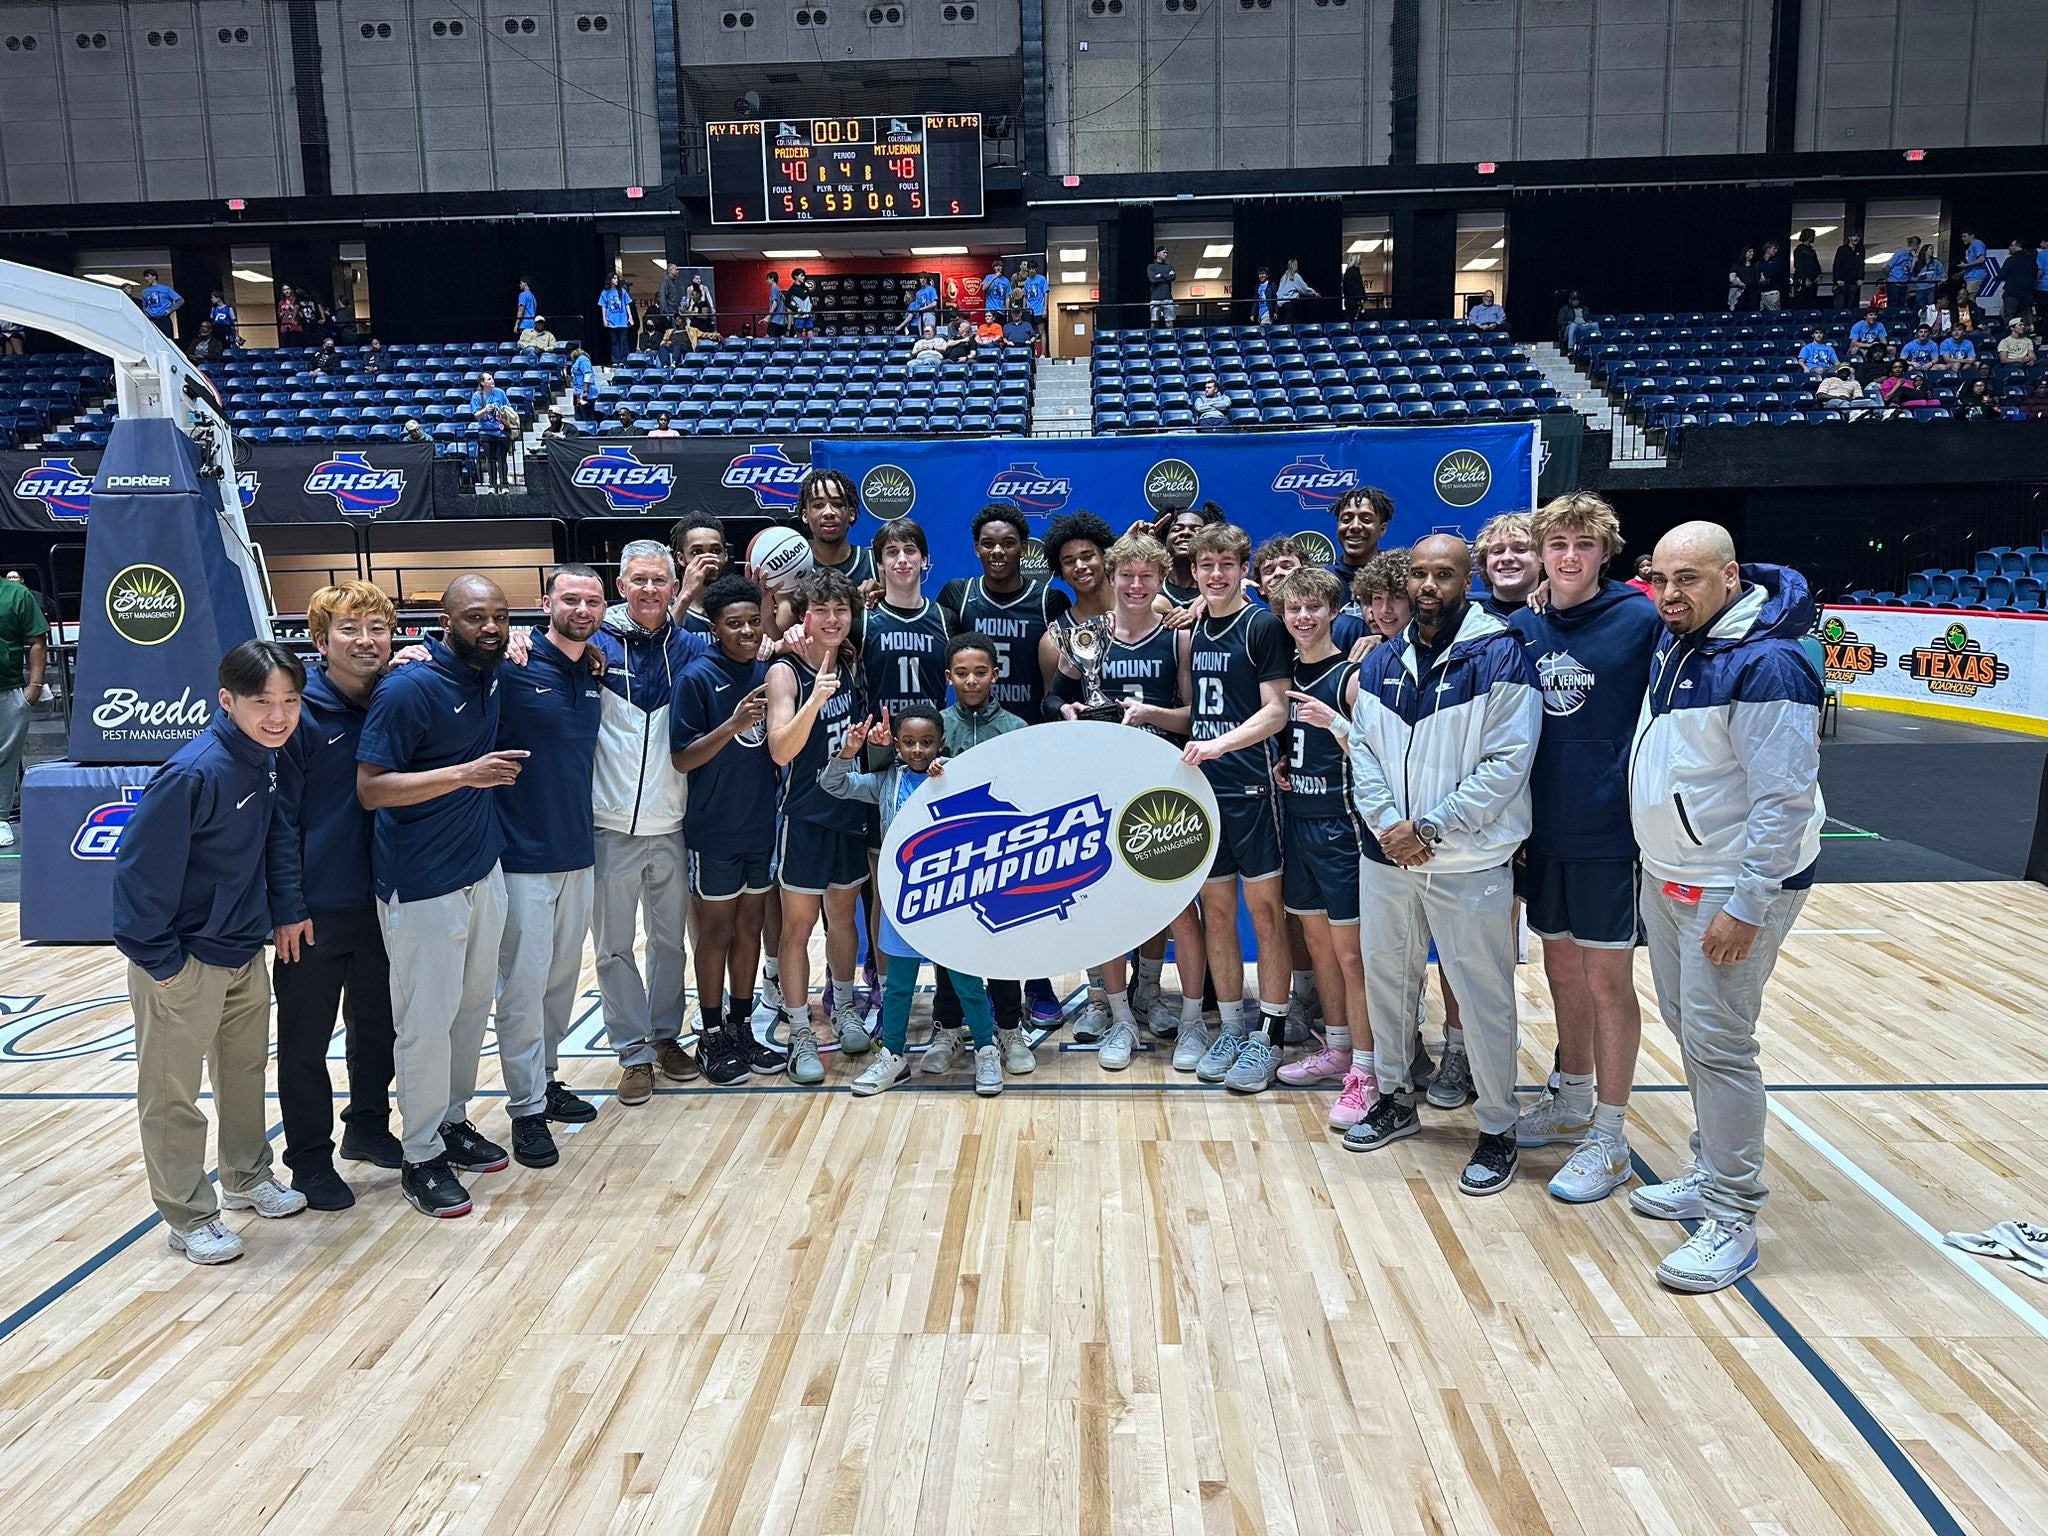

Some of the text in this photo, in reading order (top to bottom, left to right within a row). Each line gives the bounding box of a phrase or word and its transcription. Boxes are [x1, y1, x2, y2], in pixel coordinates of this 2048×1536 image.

[709, 123, 760, 136] PLY FL PTS
[815, 121, 859, 142] 00.0
[927, 116, 978, 128] PLY FL PTS
[775, 147, 809, 159] PAIDEIA
[874, 144, 920, 155] MT.VERNON
[781, 160, 807, 181] 40
[840, 162, 850, 177] 4
[889, 158, 915, 179] 48
[772, 186, 793, 194] FOULS
[838, 184, 854, 192] FOUL
[862, 183, 874, 191] PTS
[899, 182, 919, 190] FOULS
[107, 475, 170, 488] porter
[307, 472, 403, 492] GHSA
[574, 466, 673, 485] GHSA
[1273, 472, 1357, 490] GHSA
[1439, 464, 1488, 483] Breda
[16, 479, 94, 496] GHS
[865, 481, 911, 497] Breda
[989, 478, 1070, 496] GHSA
[1149, 476, 1194, 492] Breda
[766, 540, 806, 571] Wilson
[1020, 554, 1049, 568] reda
[1309, 548, 1331, 562] eda
[113, 588, 178, 612] Breda
[134, 611, 176, 619] MANAGEMENT
[974, 617, 1029, 638] MOUNT
[880, 632, 934, 652] MOUNT
[993, 642, 1010, 678] 5
[1192, 652, 1231, 672] MOUNT
[1825, 645, 1872, 671] XAS
[1916, 651, 1994, 684] TEXAS
[898, 656, 920, 693] 11
[1102, 660, 1162, 679] MOUNT
[1540, 674, 1595, 687] UNT VERNON
[1929, 680, 1977, 695] ROADHOUSE
[990, 684, 1031, 702] RNON
[1198, 677, 1224, 715] 13
[93, 686, 210, 728] Breda
[103, 730, 129, 740] PEST
[1290, 728, 1305, 769] 3
[1125, 809, 1204, 853] Breda
[907, 801, 1105, 885] GHSA
[1134, 833, 1205, 862] PEST MANAGEMENT
[901, 829, 1102, 920] CHAMPIONS
